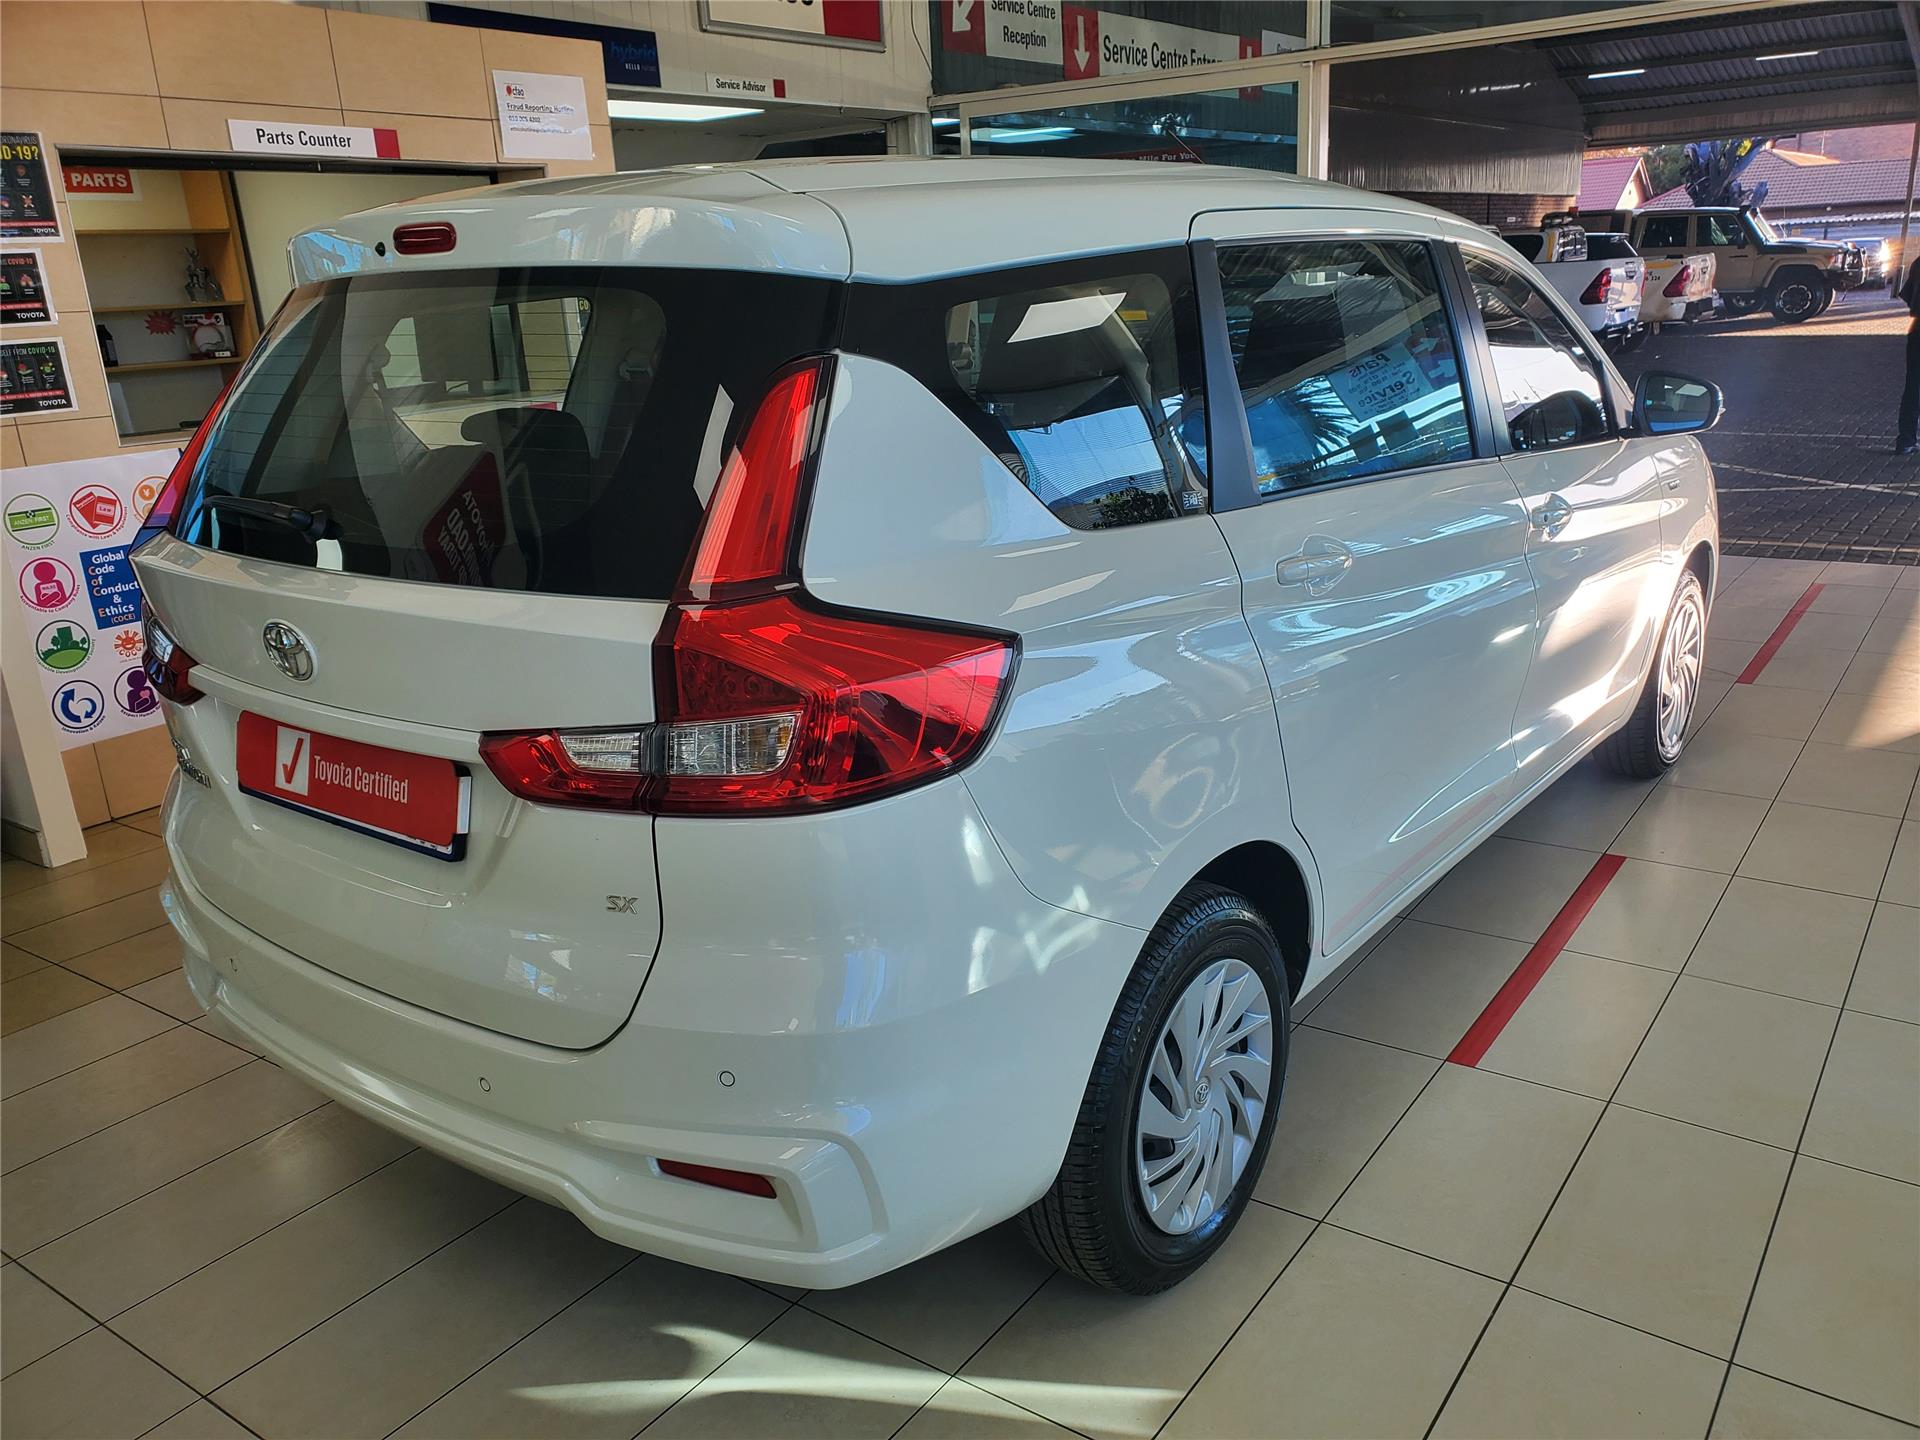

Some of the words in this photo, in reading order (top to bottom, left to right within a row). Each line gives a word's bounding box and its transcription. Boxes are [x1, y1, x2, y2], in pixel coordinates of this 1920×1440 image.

[991, 0, 1025, 15] Service
[1027, 0, 1056, 19] Centre
[1003, 25, 1047, 50] Reception
[1103, 34, 1148, 67] Service
[1151, 42, 1188, 69] Centre
[716, 78, 740, 90] Service
[742, 80, 766, 92] Advisor
[525, 103, 553, 113] Reporting
[256, 128, 294, 145] Parts
[299, 130, 351, 148] Counter
[0, 145, 39, 160] ID-19?
[70, 172, 128, 188] PARTS
[16, 311, 45, 319] TOYOTA
[39, 399, 67, 407] TOYOTA
[92, 550, 125, 564] Global
[88, 563, 115, 575] Code
[91, 575, 103, 586] of
[93, 581, 139, 596] Conduct
[113, 594, 123, 603] &
[98, 604, 134, 617] Ethics
[111, 613, 136, 624] (COCE)
[314, 755, 352, 788] Toyota
[354, 766, 409, 804] Certified
[607, 895, 639, 914] SX
